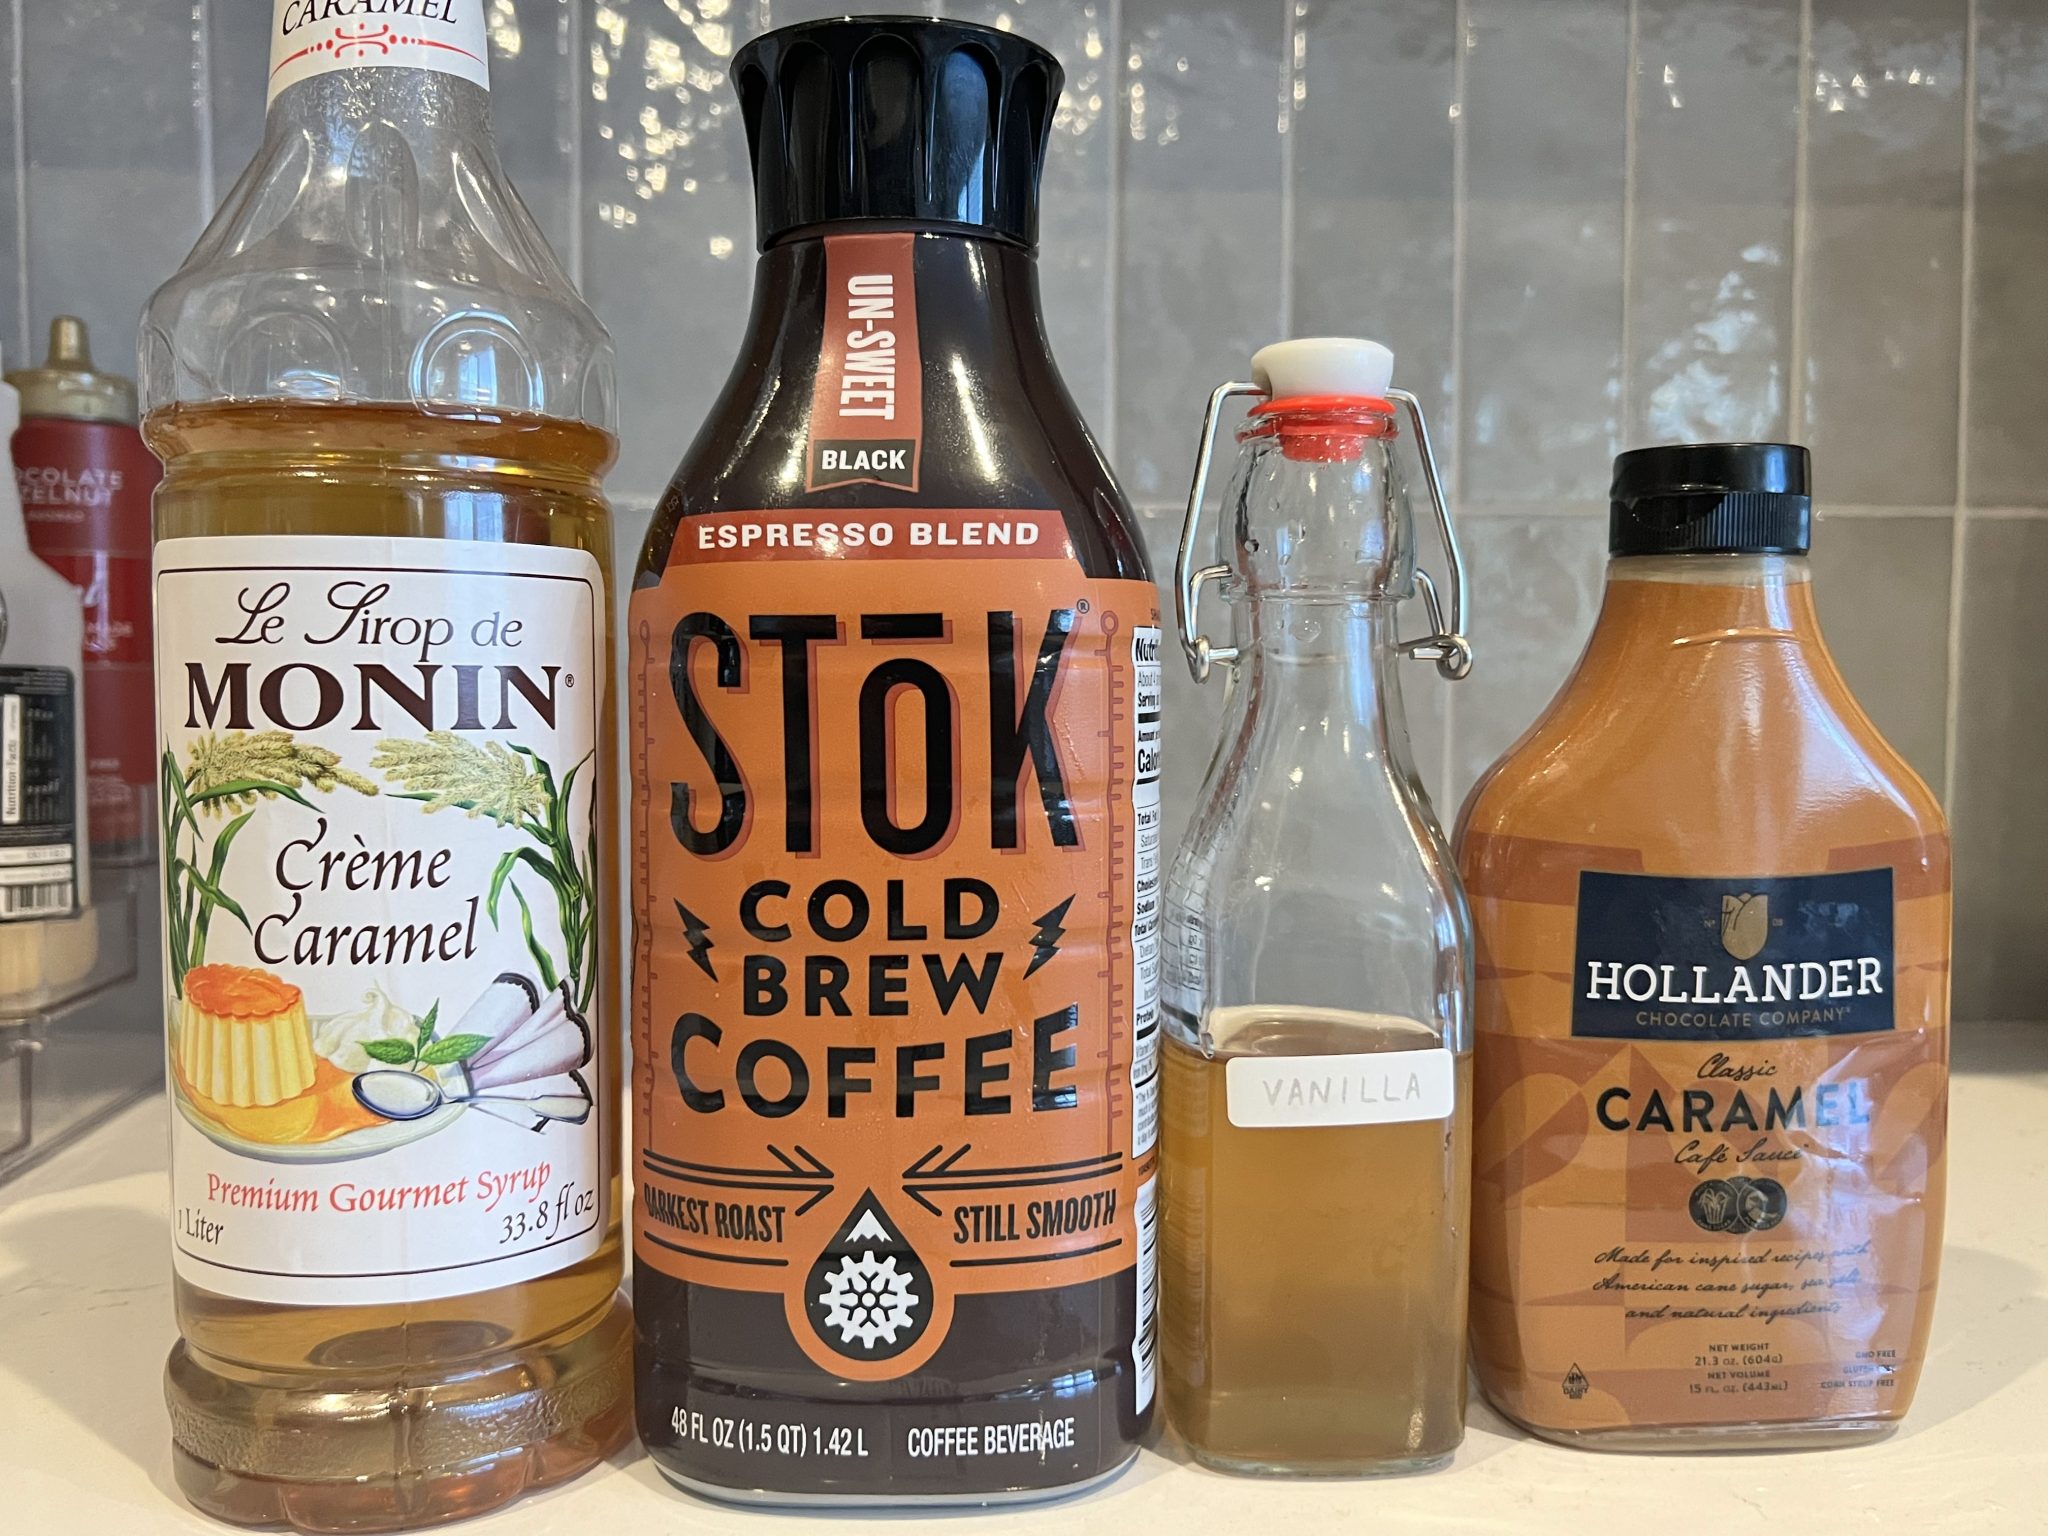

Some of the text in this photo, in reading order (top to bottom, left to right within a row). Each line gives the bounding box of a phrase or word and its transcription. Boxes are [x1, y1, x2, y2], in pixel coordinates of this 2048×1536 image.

[838, 274, 896, 420] UN-SWEET
[821, 449, 906, 471] BLACK
[698, 521, 1039, 550] ESPRESSO BLEND
[215, 580, 523, 662] Le Sirop de
[275, 817, 452, 892] Crème
[253, 892, 479, 966] Caramel
[739, 877, 1000, 943] COLD
[743, 952, 1004, 1017] BREW
[1586, 957, 1883, 1004] HOLLANDER
[1635, 1010, 1751, 1027] CHOCOLATE
[671, 1001, 1079, 1119] COFFEE
[1697, 1052, 1779, 1081] Classic
[1262, 1072, 1421, 1106] VANILLA
[1596, 1083, 1870, 1133] CARAMEL
[1674, 1138, 1728, 1175] Café
[207, 1160, 552, 1213] Premium Gourmet Syrup
[185, 1208, 225, 1245] Liter
[499, 1183, 595, 1244] 33.8 fl oz
[644, 1182, 787, 1243] DARKEST ROAST
[953, 1188, 1117, 1244] STILL SMOOTH
[1594, 1246, 1650, 1264] Made
[1653, 1249, 1683, 1271] for
[1689, 1249, 1772, 1272] inspired
[1774, 1249, 1825, 1269] recipes
[1592, 1272, 1689, 1291] American
[1695, 1281, 1736, 1292] cane
[1625, 1301, 1841, 1325] and natural ingredients
[1694, 1355, 1719, 1366] 21.3
[1709, 1343, 1770, 1353] NET WEIGHT
[1689, 1383, 1702, 1394] 15
[1707, 1370, 1771, 1380] NET VOLUME
[671, 1405, 869, 1457] 48 FL OZ (1.5 QT) 1.42 L
[907, 1416, 1075, 1458] COFFEE BEVERAGE
